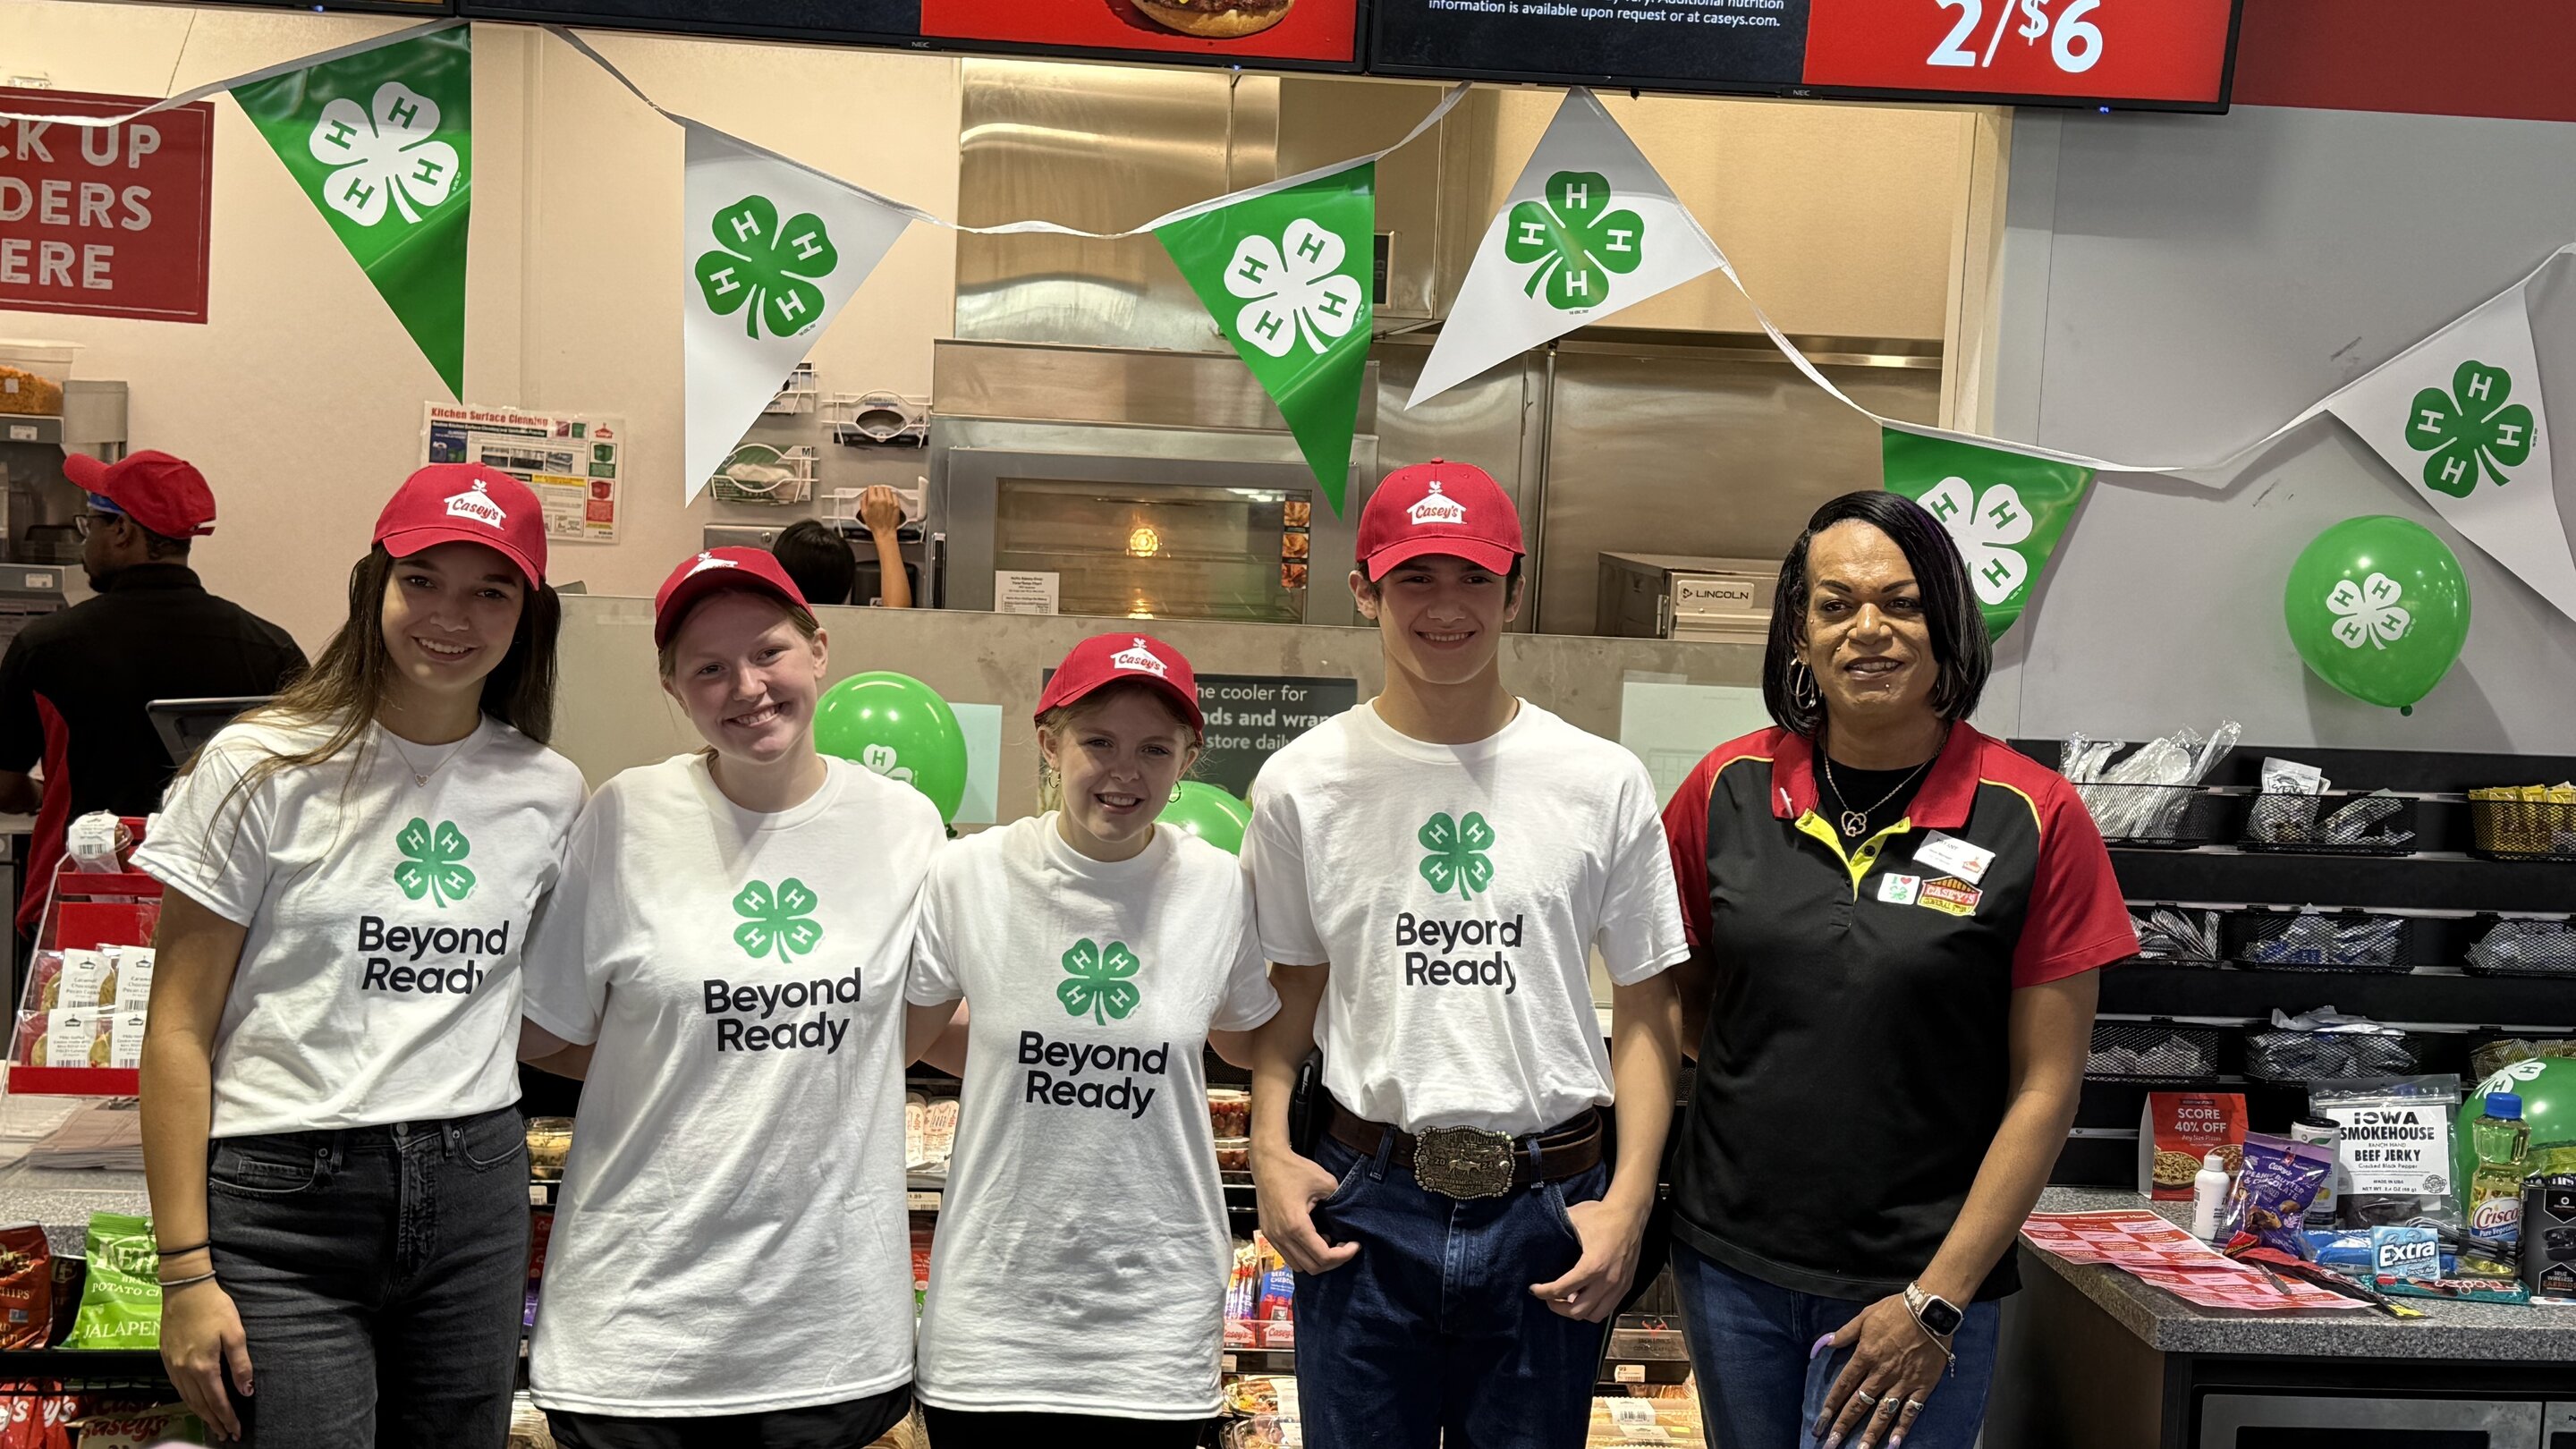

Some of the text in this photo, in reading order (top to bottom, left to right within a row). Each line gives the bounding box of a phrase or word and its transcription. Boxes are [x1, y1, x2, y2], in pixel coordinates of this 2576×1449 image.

[1509, 1, 1519, 13] is
[1522, 3, 1578, 16] available
[1580, 7, 1614, 21] upon
[1617, 9, 1666, 23] request
[1669, 12, 1682, 22] or
[1687, 12, 1699, 23] at
[1703, 13, 1781, 29] caseys.com.
[388, 97, 419, 130] H
[81, 123, 161, 168] UP
[324, 119, 358, 150] H
[411, 157, 444, 186] H
[0, 176, 152, 232] DERS
[343, 177, 375, 210] H
[1565, 183, 1588, 209] H
[730, 209, 761, 242] H
[1518, 222, 1546, 245] H
[791, 231, 824, 261] H
[1296, 232, 1326, 265] H
[1606, 229, 1633, 252] H
[0, 237, 114, 290] ERE
[1238, 255, 1269, 284] H
[708, 267, 741, 296] H
[1565, 270, 1589, 297] H
[775, 288, 807, 322] H
[1318, 291, 1348, 318] H
[1254, 309, 1284, 342] H
[2467, 372, 2493, 402] H
[431, 407, 549, 427] Kitchen Surface Cleaning
[2417, 409, 2445, 434] H
[2496, 423, 2522, 447] H
[2440, 456, 2467, 485] H
[452, 497, 499, 521] Casey's
[1415, 504, 1459, 519] Casey's
[1930, 492, 1959, 522] H
[1987, 500, 2018, 530] H
[1981, 558, 2011, 589] H
[1696, 589, 1750, 600] LINCOLN
[2334, 589, 2354, 608] H
[2371, 580, 2392, 599] H
[2342, 622, 2361, 641] H
[2380, 614, 2402, 632] H
[1118, 654, 1161, 671] Casey's
[1221, 683, 1275, 700] cooler
[1281, 685, 1308, 702] for
[1239, 708, 1276, 726] and
[1207, 734, 1250, 749] store
[872, 750, 886, 767] H
[406, 828, 425, 851] H
[440, 832, 460, 853] H
[1428, 823, 1449, 844] H
[1466, 822, 1485, 843] H
[402, 868, 422, 889] H
[445, 870, 466, 890] H
[1429, 861, 1449, 882] H
[1470, 860, 1487, 882] H
[743, 890, 766, 911] H
[784, 888, 806, 910] H
[1926, 886, 1975, 904] CASEY'S
[358, 915, 510, 962] Beyond
[744, 928, 767, 949] H
[792, 925, 813, 945] H
[1072, 949, 1091, 970] H
[1109, 953, 1130, 971] H
[1405, 951, 1517, 995] Ready
[703, 967, 861, 1020] Beyond
[1065, 985, 1087, 1005] H
[1110, 987, 1131, 1009] H
[717, 1011, 851, 1055] Ready
[1019, 1030, 1169, 1077] Beyond
[1026, 1070, 1157, 1120] Ready
[2177, 1107, 2221, 1120] SCORE
[2174, 1122, 2227, 1133] 40% OFF
[2340, 1126, 2435, 1140] SMOKEHOUSE
[2354, 1149, 2421, 1162] BEEF JERKY
[2476, 1207, 2519, 1229] Crisco
[2479, 1228, 2492, 1238] Pure
[2379, 1241, 2436, 1267] Extra
[92, 1282, 142, 1296] POTATO
